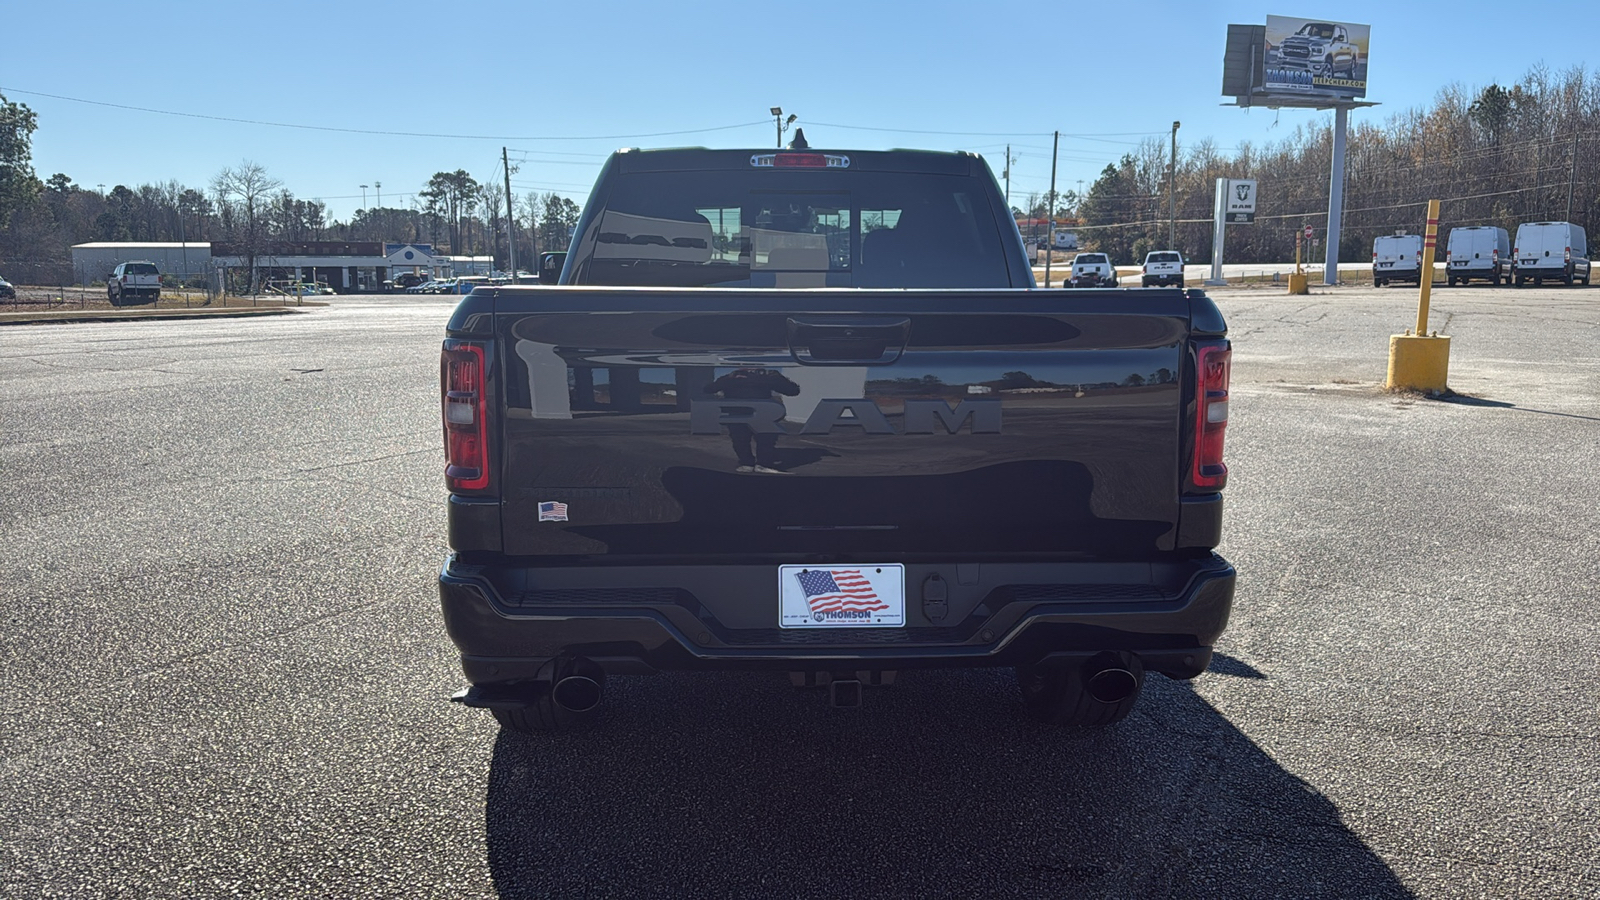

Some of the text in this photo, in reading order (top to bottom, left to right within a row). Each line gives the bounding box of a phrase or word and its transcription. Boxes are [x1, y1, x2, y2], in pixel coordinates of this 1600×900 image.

[1266, 69, 1313, 85] THOMSON
[1314, 78, 1364, 87] JEEPCHEAP.COM
[690, 398, 1003, 435] RAM
[825, 611, 871, 619] THOMSON
